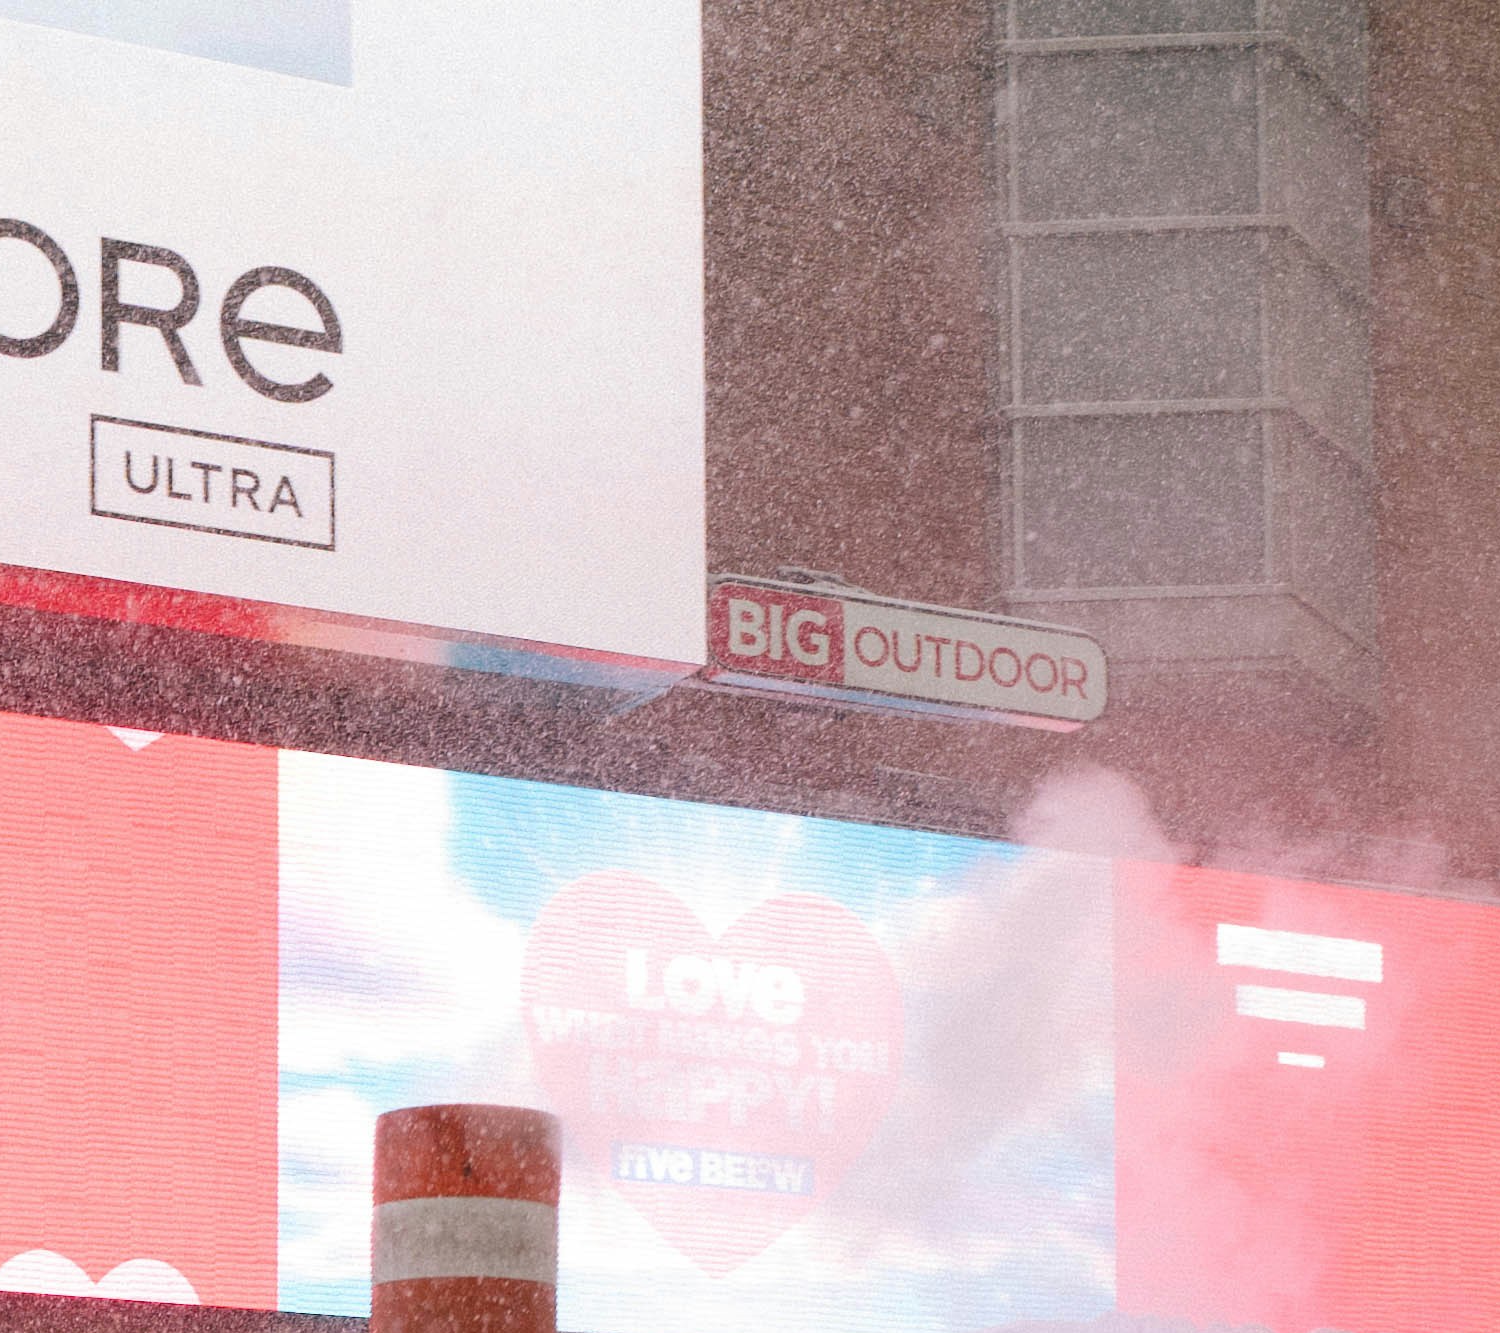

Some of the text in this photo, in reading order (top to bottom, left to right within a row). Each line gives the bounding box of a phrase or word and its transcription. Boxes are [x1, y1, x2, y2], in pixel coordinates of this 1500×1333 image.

[124, 450, 303, 519] ULTRA
[729, 599, 1089, 700] BIG OUTDOOR
